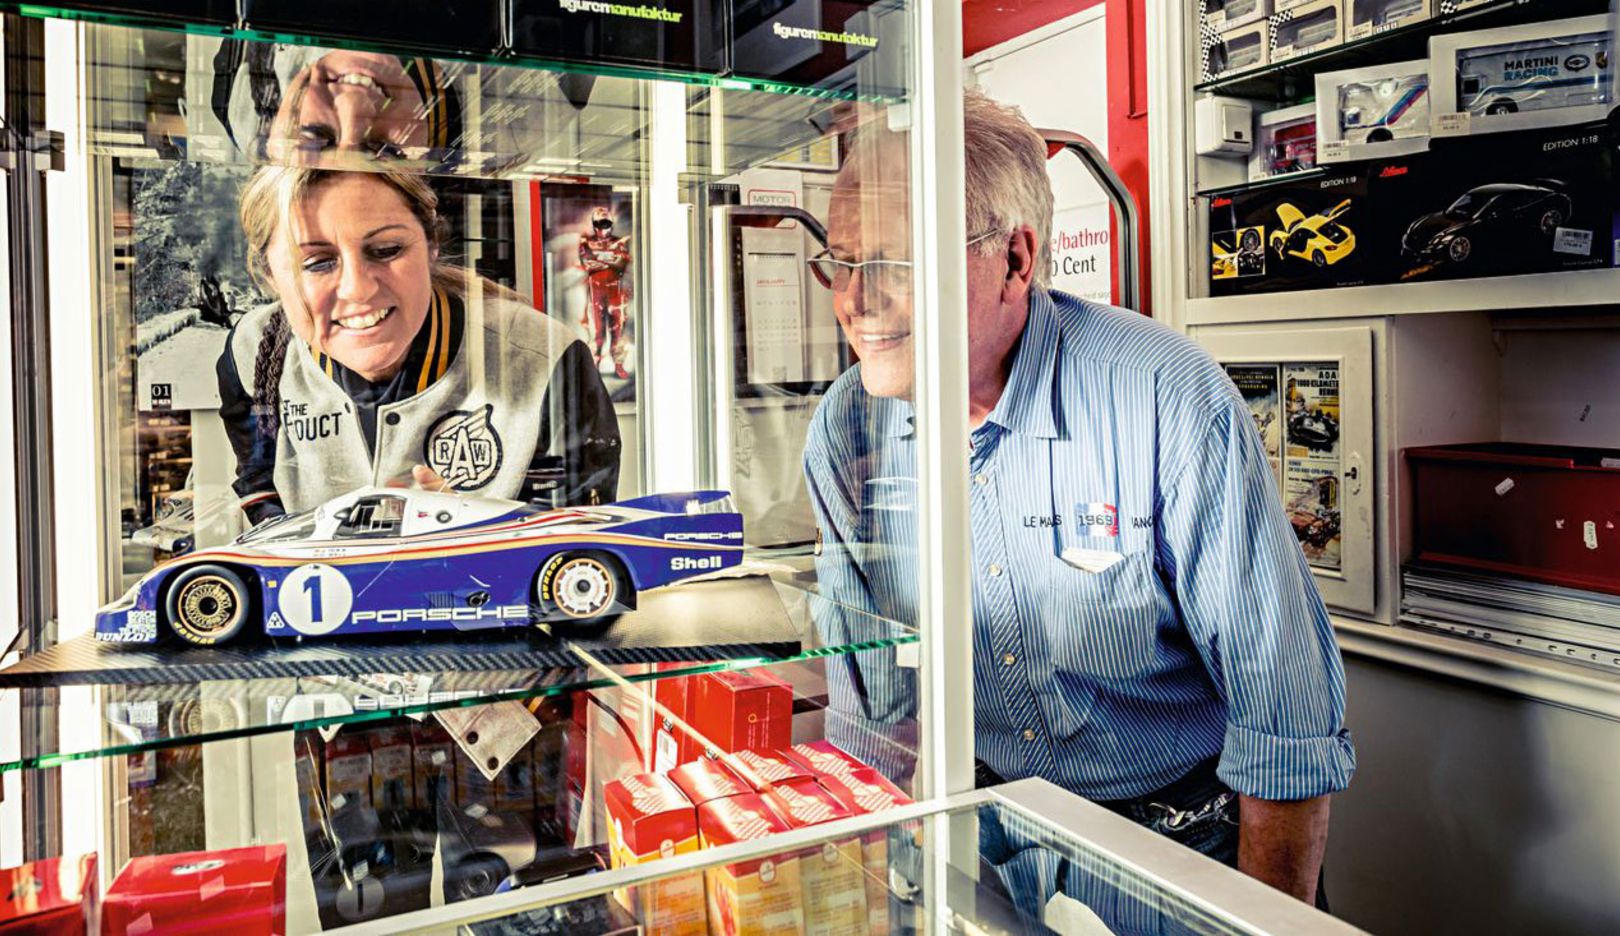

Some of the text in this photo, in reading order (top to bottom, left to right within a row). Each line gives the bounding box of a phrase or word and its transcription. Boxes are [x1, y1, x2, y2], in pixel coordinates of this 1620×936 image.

[1504, 56, 1558, 70] MARTINI
[1504, 67, 1559, 81] RACING
[1543, 135, 1598, 151] EDITION 1:18
[1063, 255, 1096, 275] Cent
[152, 385, 170, 397] 01
[290, 403, 308, 416] THE
[1024, 516, 1036, 528] LE
[1077, 514, 1113, 526] 1969
[664, 532, 743, 541] PORSCHE
[671, 556, 722, 570] Shell
[303, 575, 323, 623] 1
[352, 605, 529, 625] PORSCHE
